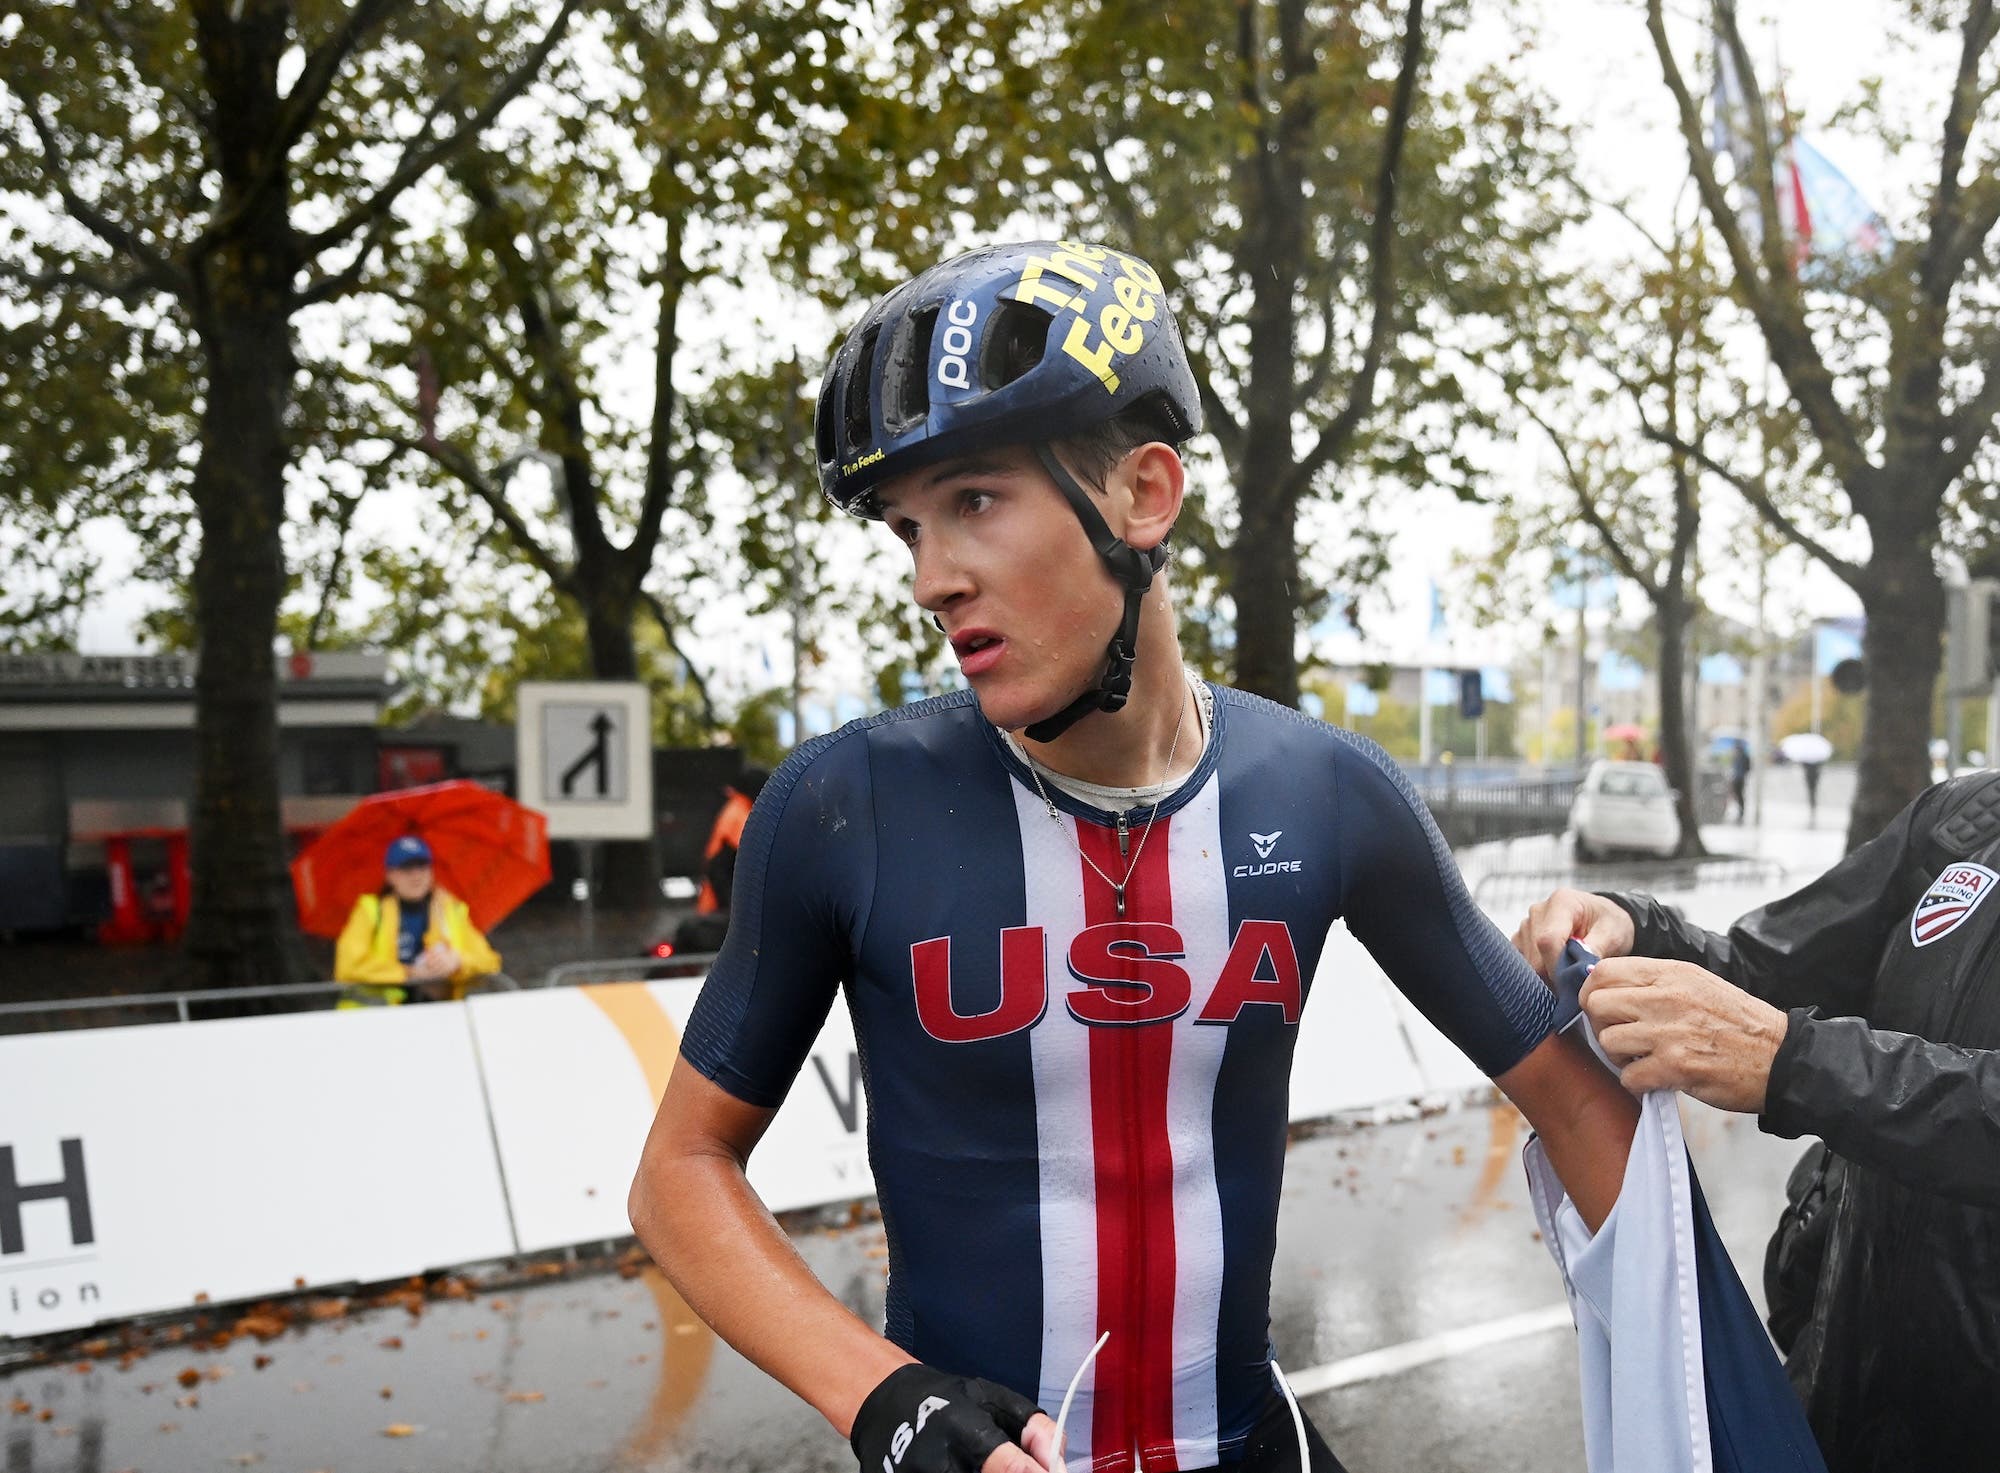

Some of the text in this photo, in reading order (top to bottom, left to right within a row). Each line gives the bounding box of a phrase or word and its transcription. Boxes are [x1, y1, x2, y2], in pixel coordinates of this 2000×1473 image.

[1015, 241, 1106, 314] The
[1062, 248, 1162, 395] Feed
[1233, 860, 1302, 878] CUORE
[1935, 884, 1974, 900] CYCLING
[1942, 870, 1982, 893] USA
[910, 919, 1302, 1044] USA
